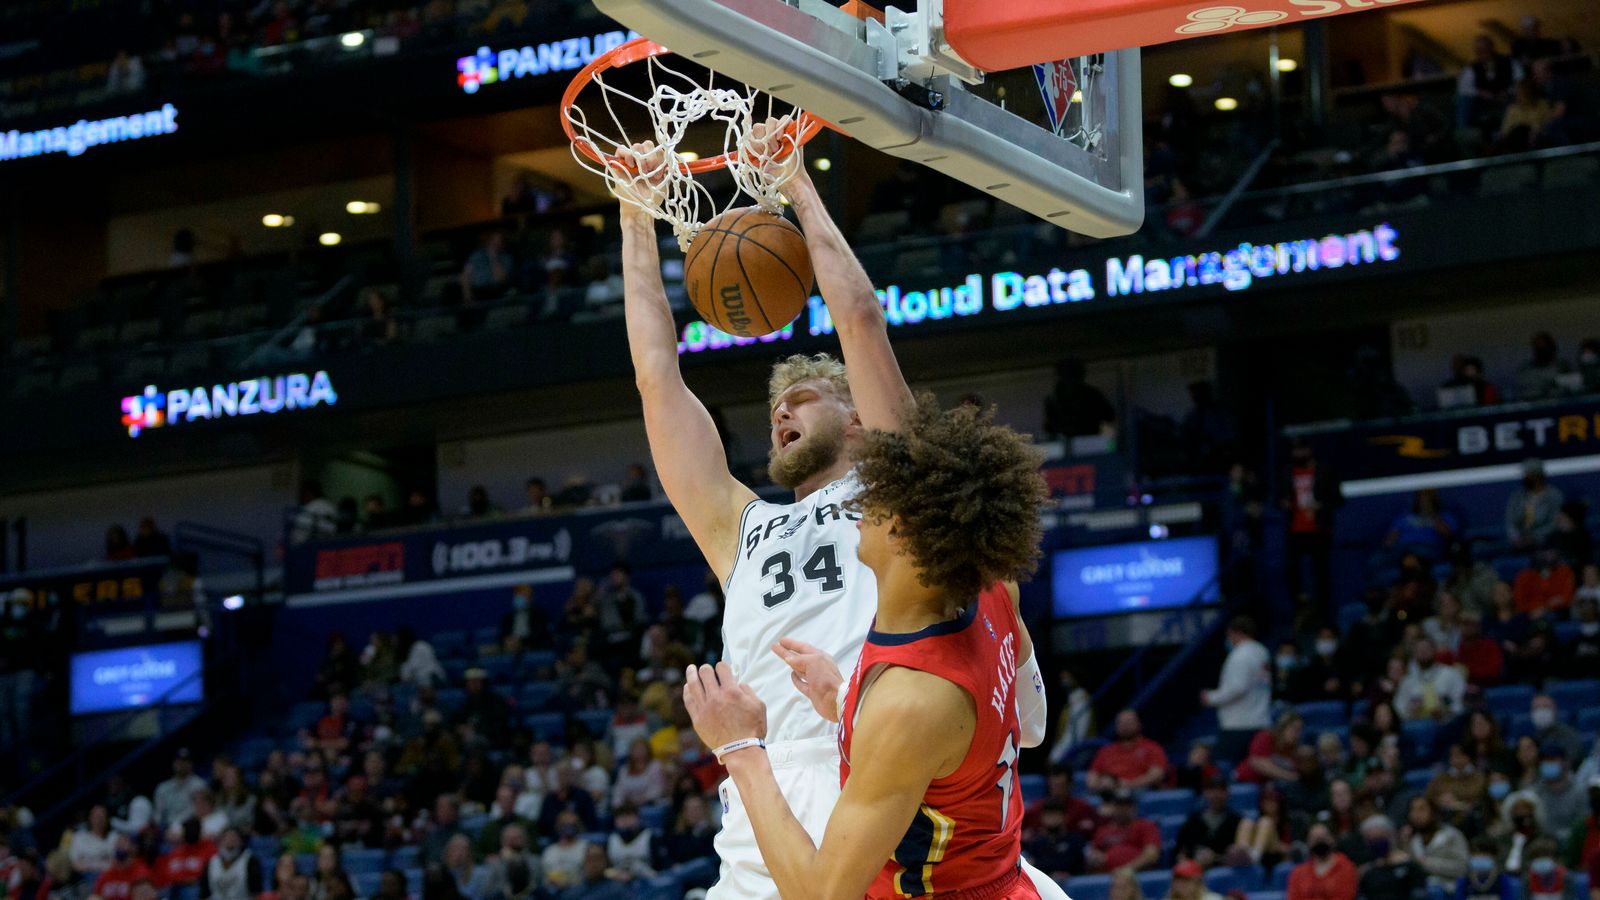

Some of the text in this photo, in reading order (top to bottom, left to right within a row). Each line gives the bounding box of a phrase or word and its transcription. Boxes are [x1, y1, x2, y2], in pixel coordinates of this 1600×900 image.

[991, 267, 1095, 312] Data
[1106, 222, 1399, 296] Management
[166, 370, 338, 425] PANZURA
[760, 541, 846, 611] 34
